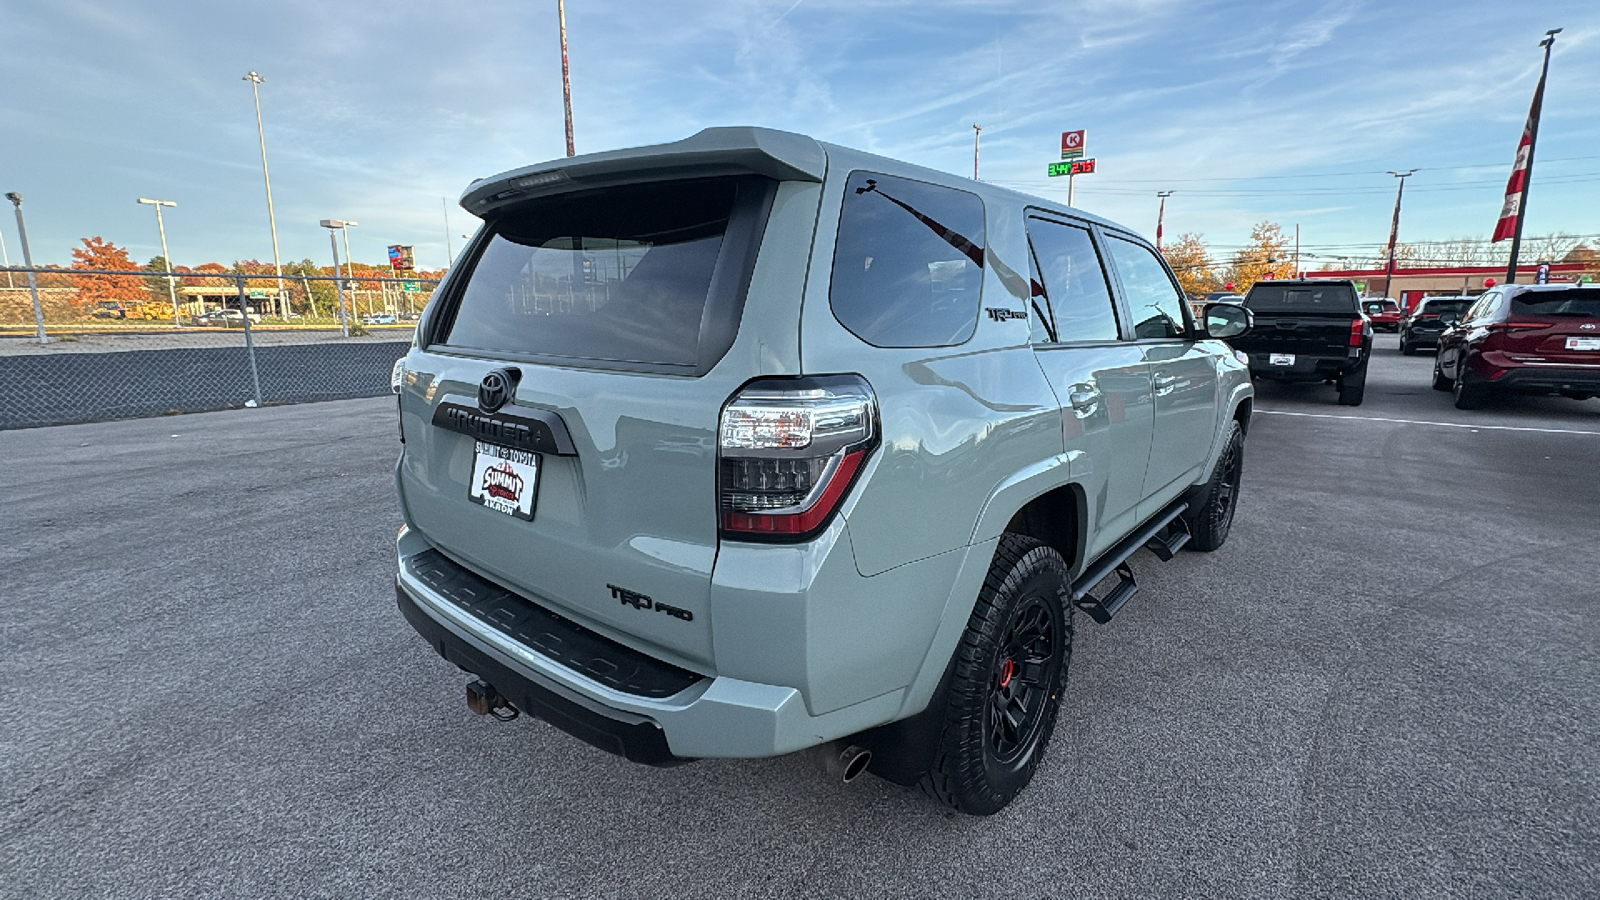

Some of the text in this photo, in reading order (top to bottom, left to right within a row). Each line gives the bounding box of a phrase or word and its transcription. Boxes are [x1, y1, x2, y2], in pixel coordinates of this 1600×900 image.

[475, 441, 536, 467] SUMMIT TOYOTA
[483, 468, 523, 499] SUMMIT
[484, 499, 514, 516] AKRON
[606, 583, 693, 621] TRD PRO
